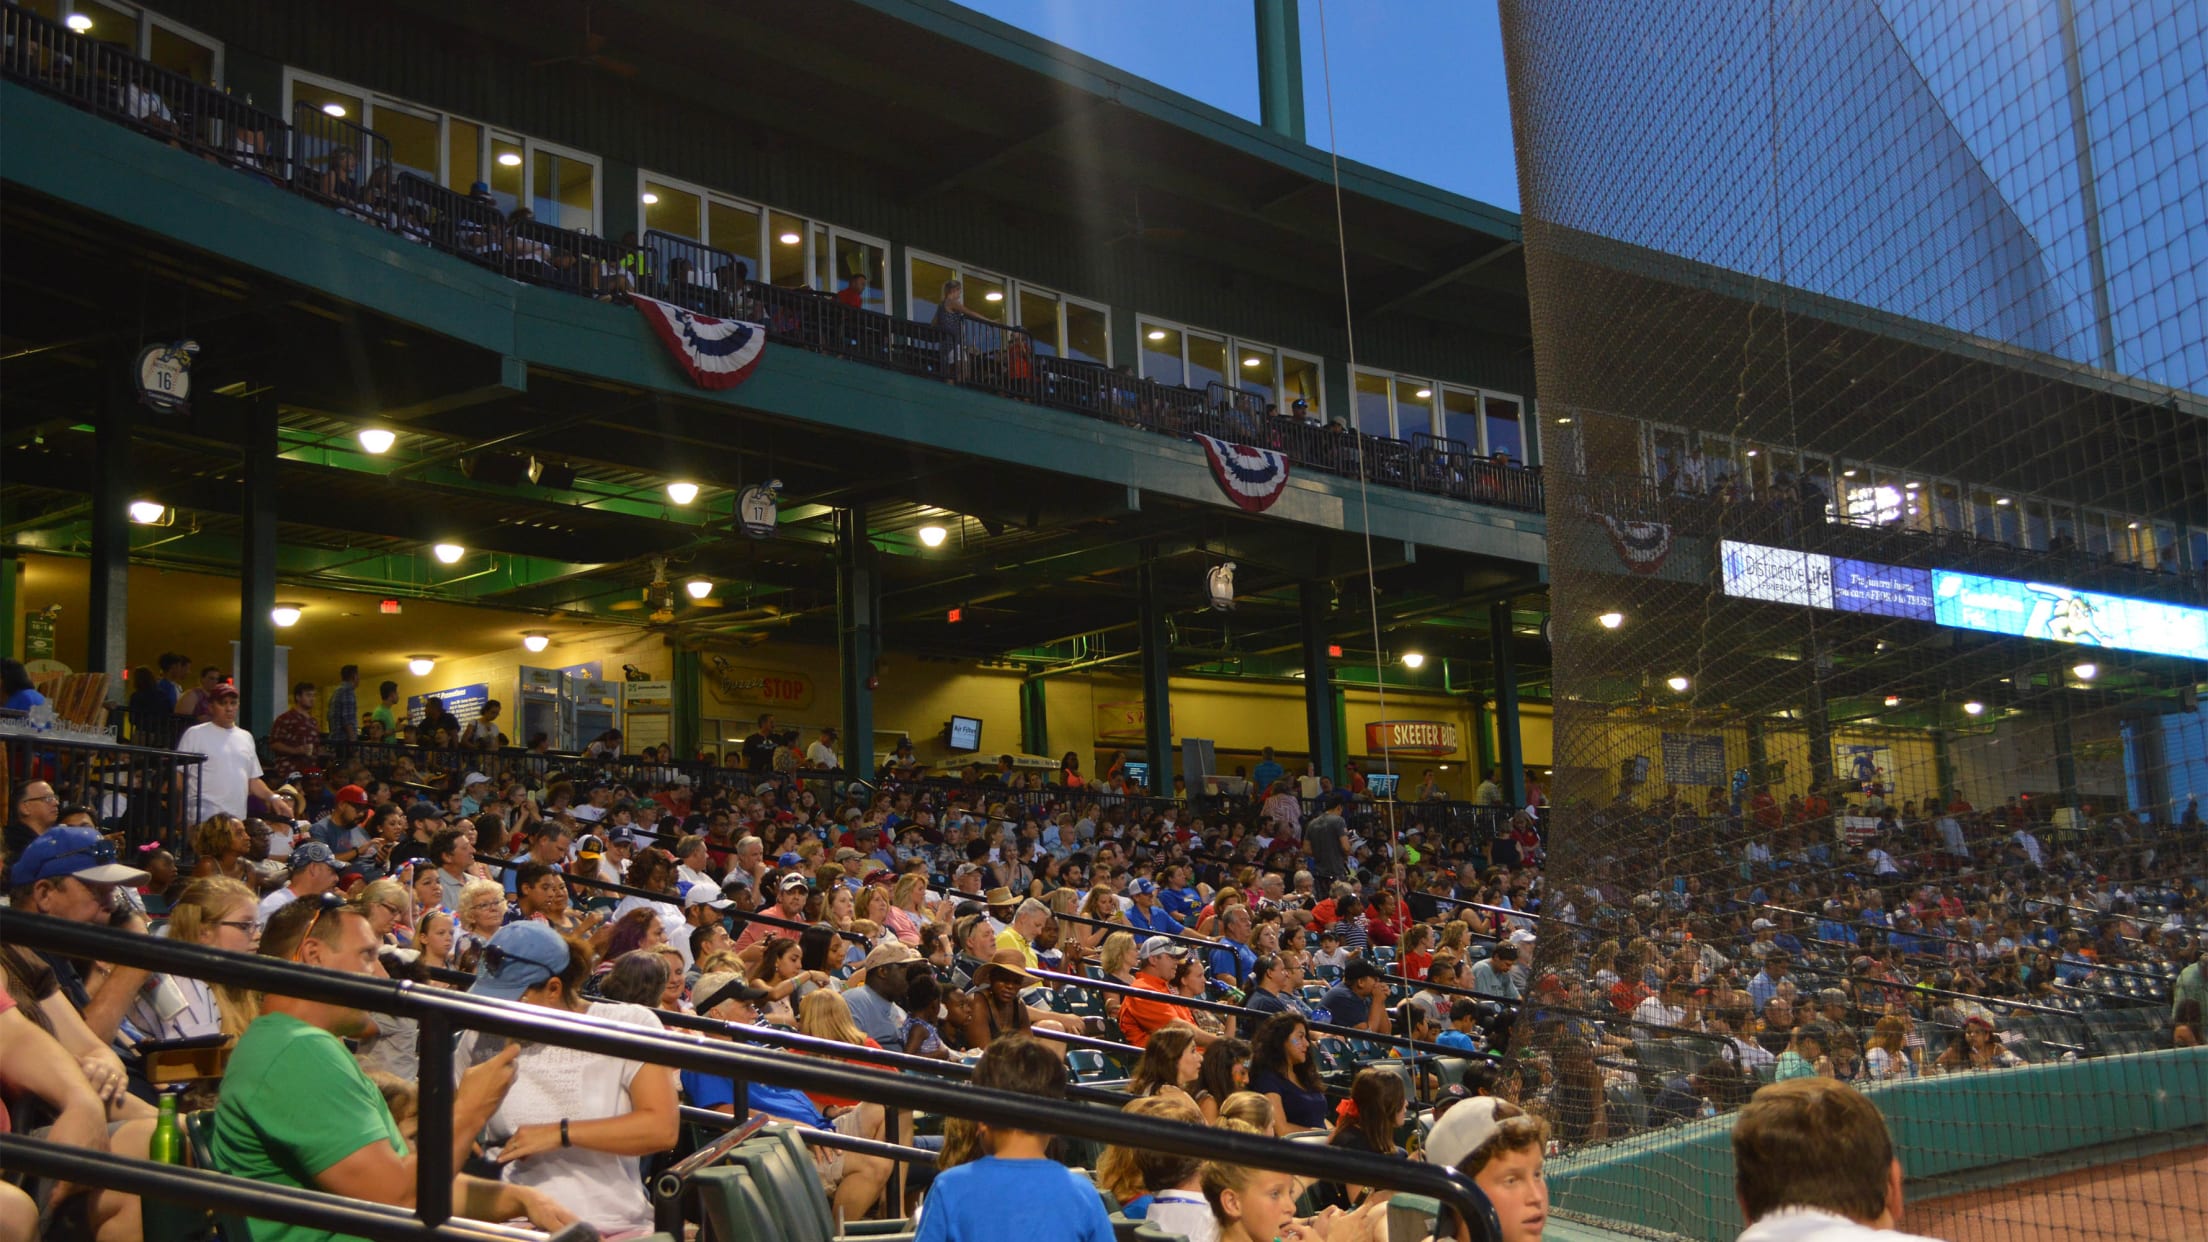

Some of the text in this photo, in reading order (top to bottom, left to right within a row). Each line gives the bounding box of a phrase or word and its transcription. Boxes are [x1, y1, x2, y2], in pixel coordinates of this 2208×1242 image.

[157, 370, 172, 390] 16
[754, 506, 764, 521] 17
[763, 676, 804, 700] STOP
[1394, 724, 1439, 745] SKEETER
